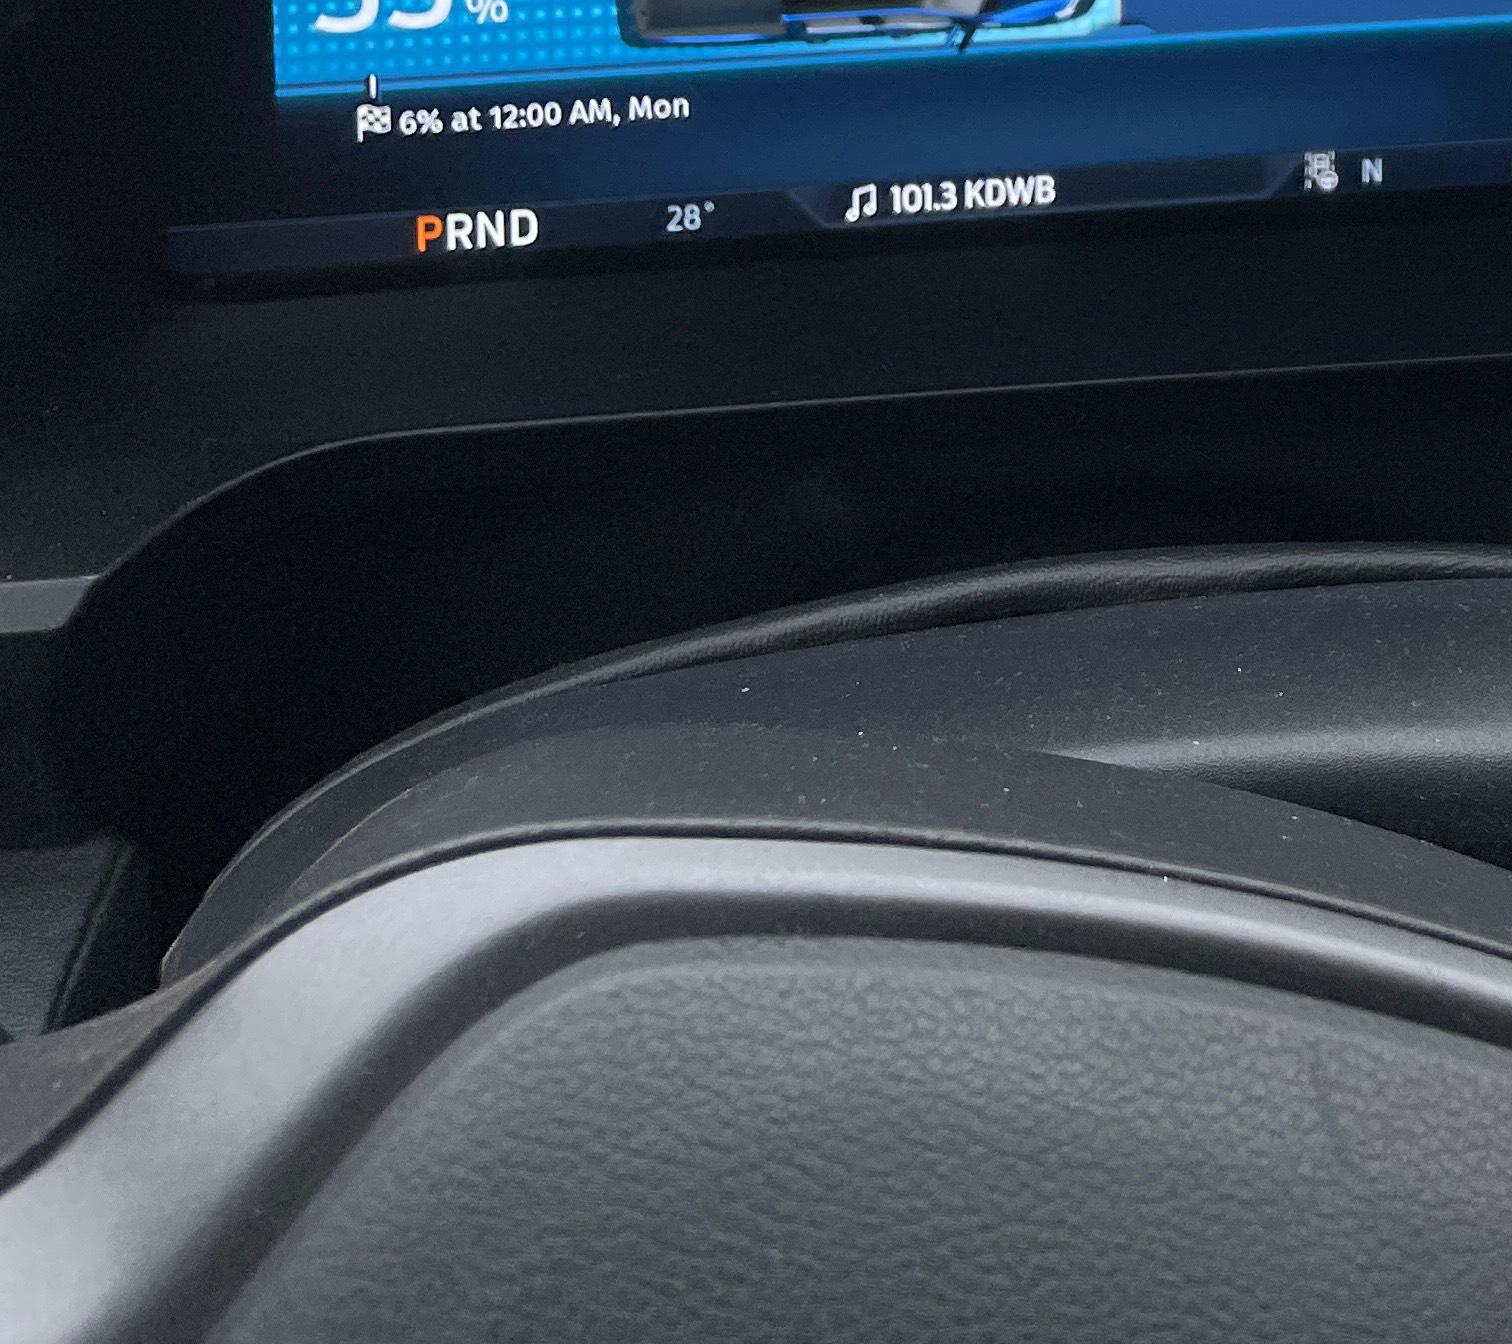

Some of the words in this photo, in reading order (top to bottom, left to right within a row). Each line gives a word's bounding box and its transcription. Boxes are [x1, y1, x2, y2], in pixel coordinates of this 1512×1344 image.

[400, 108, 444, 136] 6%
[451, 106, 482, 133] at
[489, 100, 562, 131] 12:00
[568, 97, 621, 128] AM,
[628, 94, 690, 121] Mon
[1361, 156, 1384, 184] N
[890, 180, 957, 214] 101.3
[964, 174, 1057, 210] KDWB
